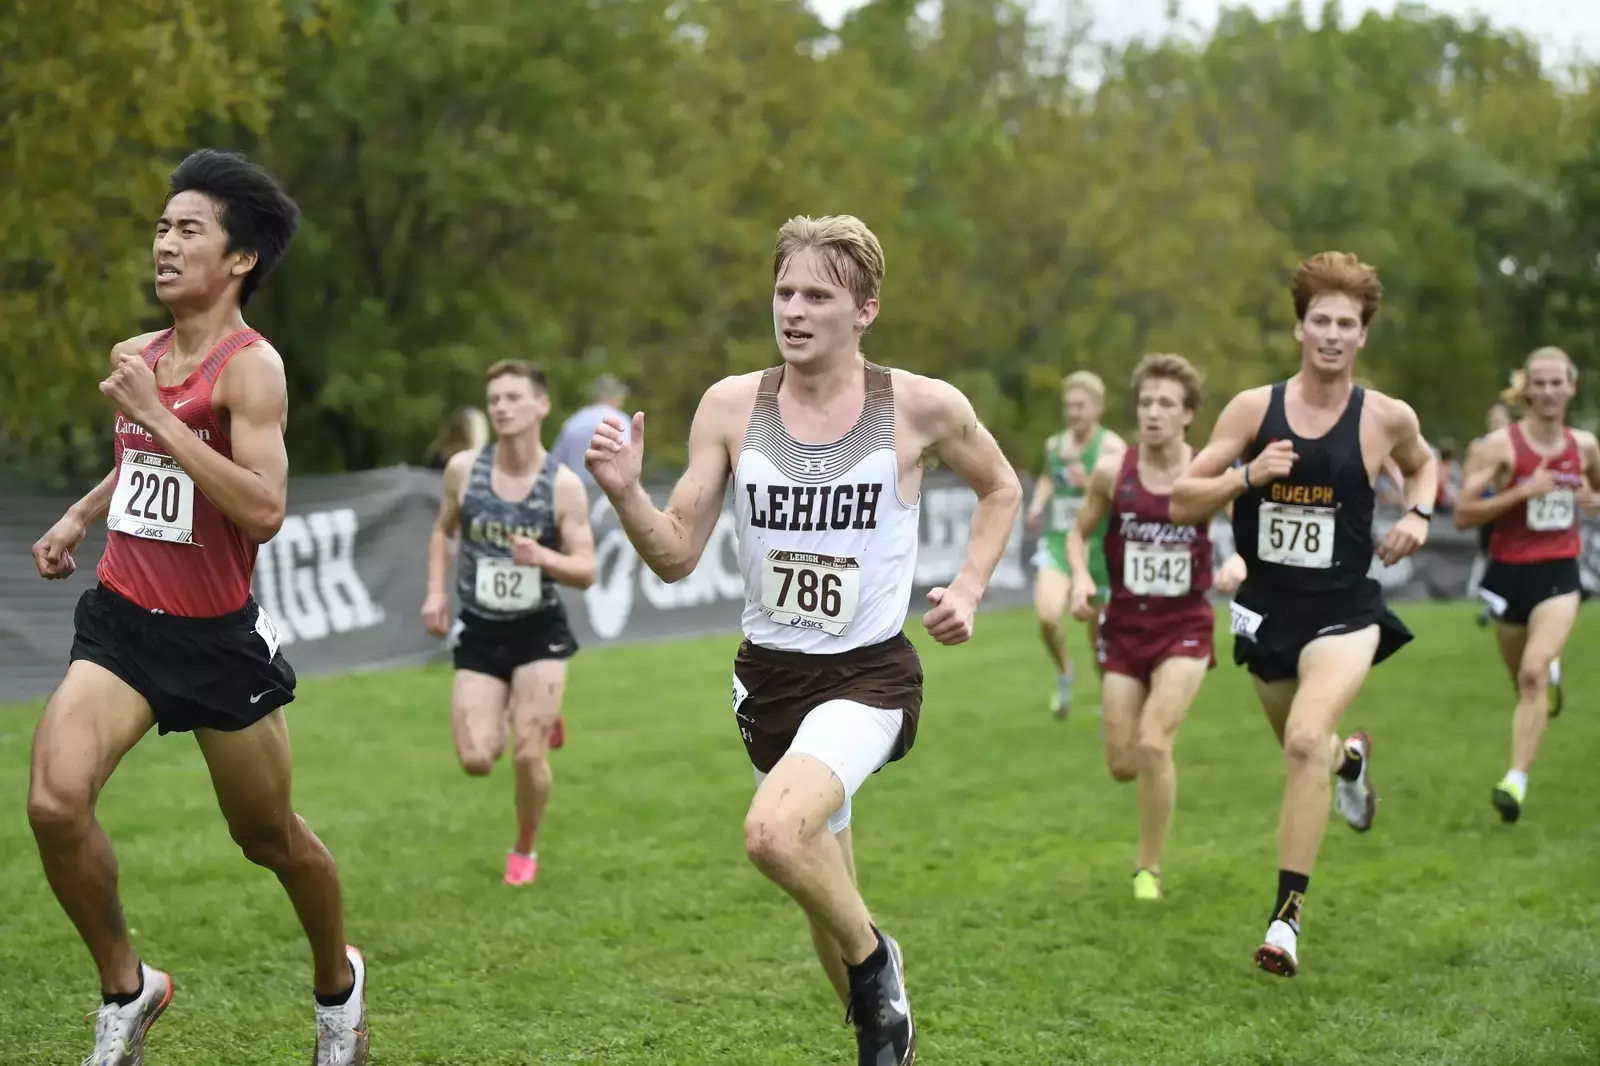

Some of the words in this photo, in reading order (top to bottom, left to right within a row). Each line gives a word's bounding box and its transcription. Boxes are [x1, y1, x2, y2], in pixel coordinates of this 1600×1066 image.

[124, 470, 180, 523] 220
[746, 483, 882, 531] LEHIGH
[1271, 483, 1334, 504] GUELPH
[1269, 517, 1320, 553] 578
[789, 553, 819, 563] LEHIGH
[1131, 556, 1187, 583] 1542
[493, 571, 522, 598] 62
[773, 566, 842, 617] 786
